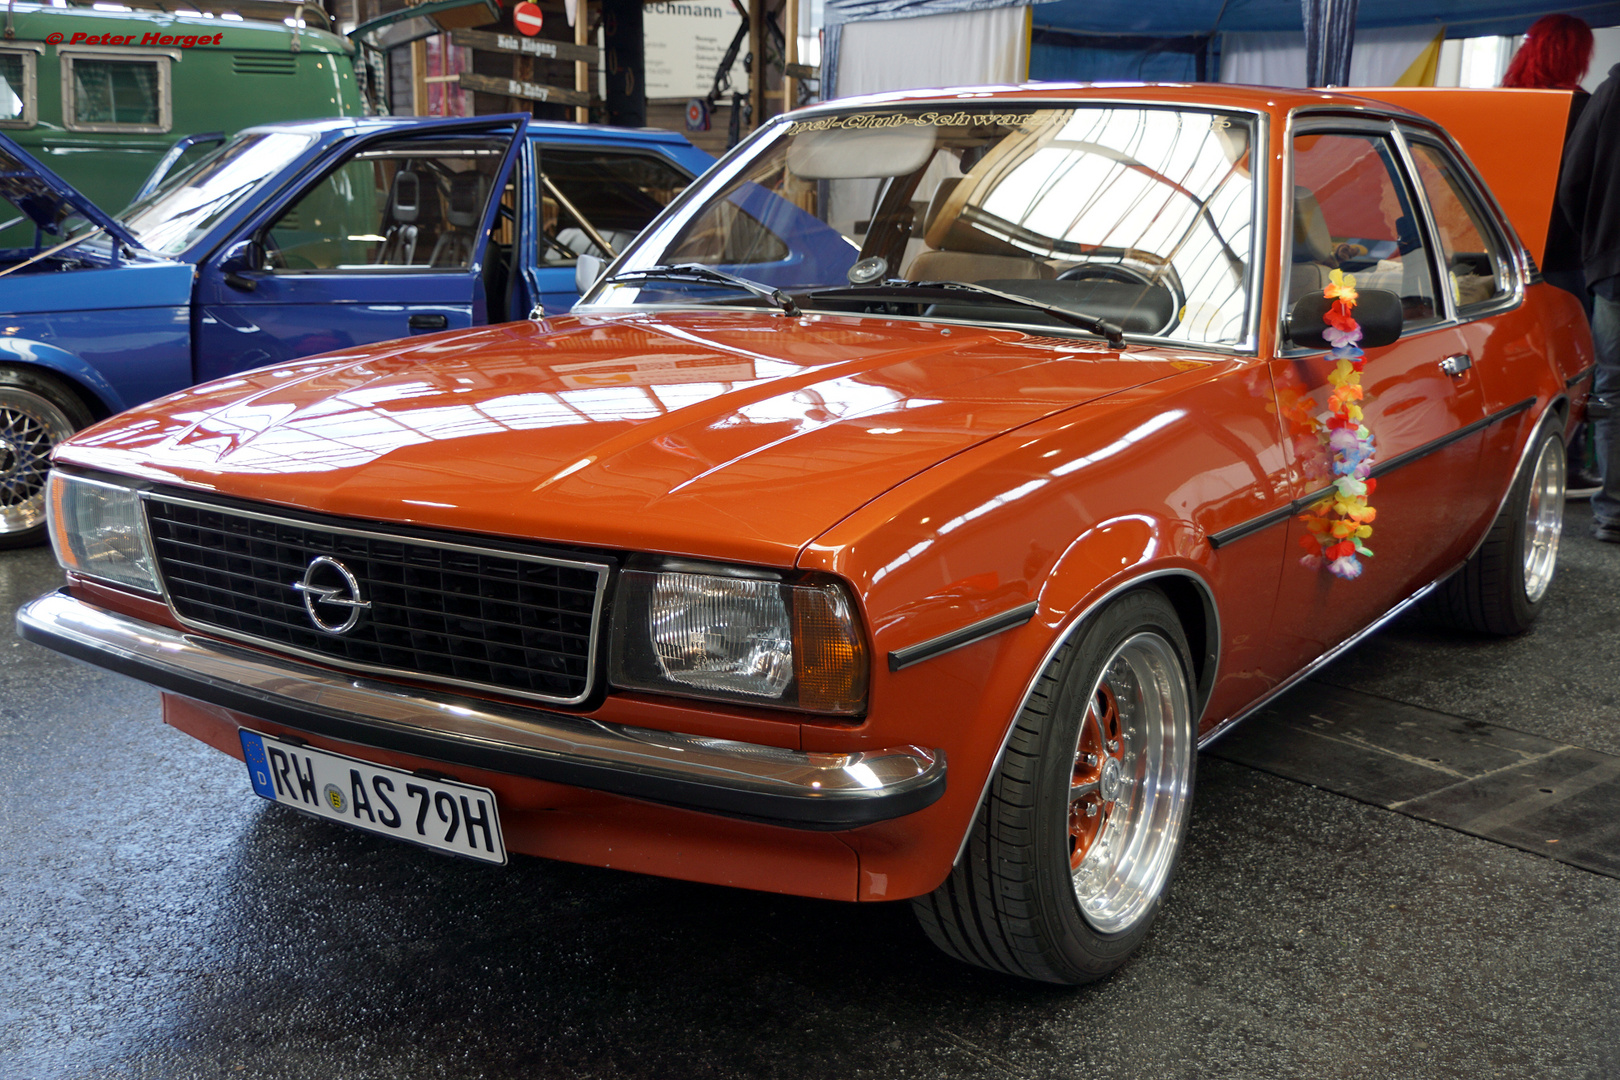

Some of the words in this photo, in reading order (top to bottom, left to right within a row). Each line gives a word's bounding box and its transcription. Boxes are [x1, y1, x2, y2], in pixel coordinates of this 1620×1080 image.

[498, 34, 519, 50] Kein
[508, 79, 522, 95] No
[523, 82, 549, 102] Entry
[257, 770, 267, 786] D
[268, 746, 319, 807] RW
